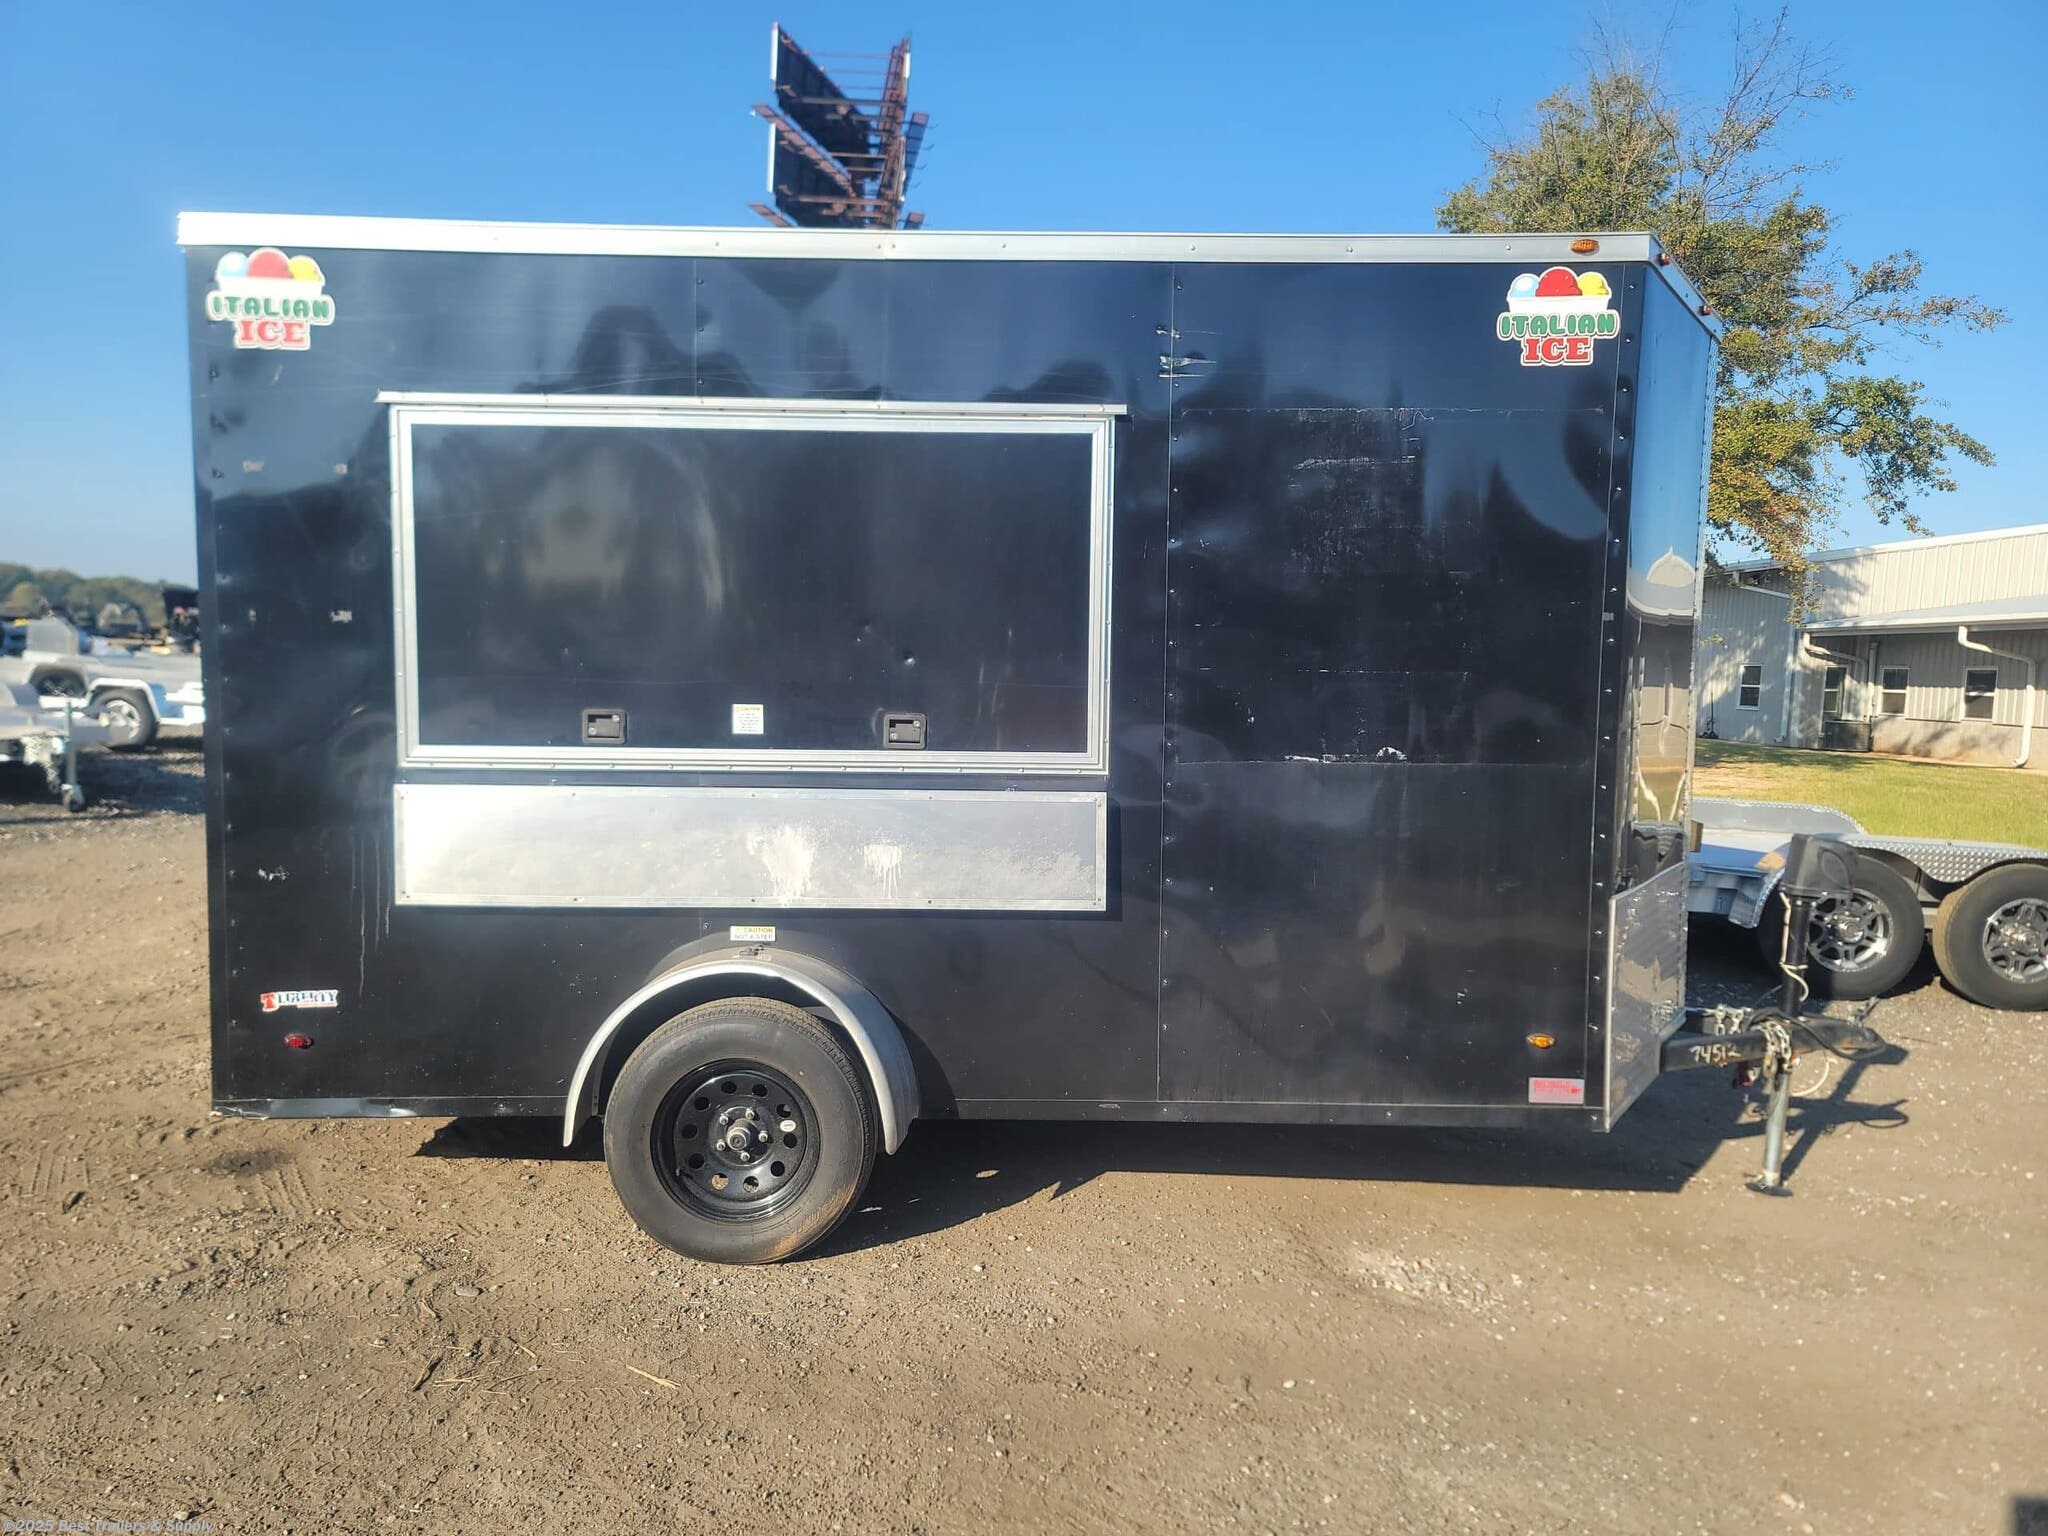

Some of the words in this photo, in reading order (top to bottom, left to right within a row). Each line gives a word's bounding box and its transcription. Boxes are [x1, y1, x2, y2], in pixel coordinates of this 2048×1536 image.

[212, 295, 330, 319] ITALIAN
[239, 320, 305, 342] ICE
[1500, 313, 1616, 337] ITALIAN
[1525, 337, 1590, 361] ICE
[278, 991, 337, 1003] LIBERTY
